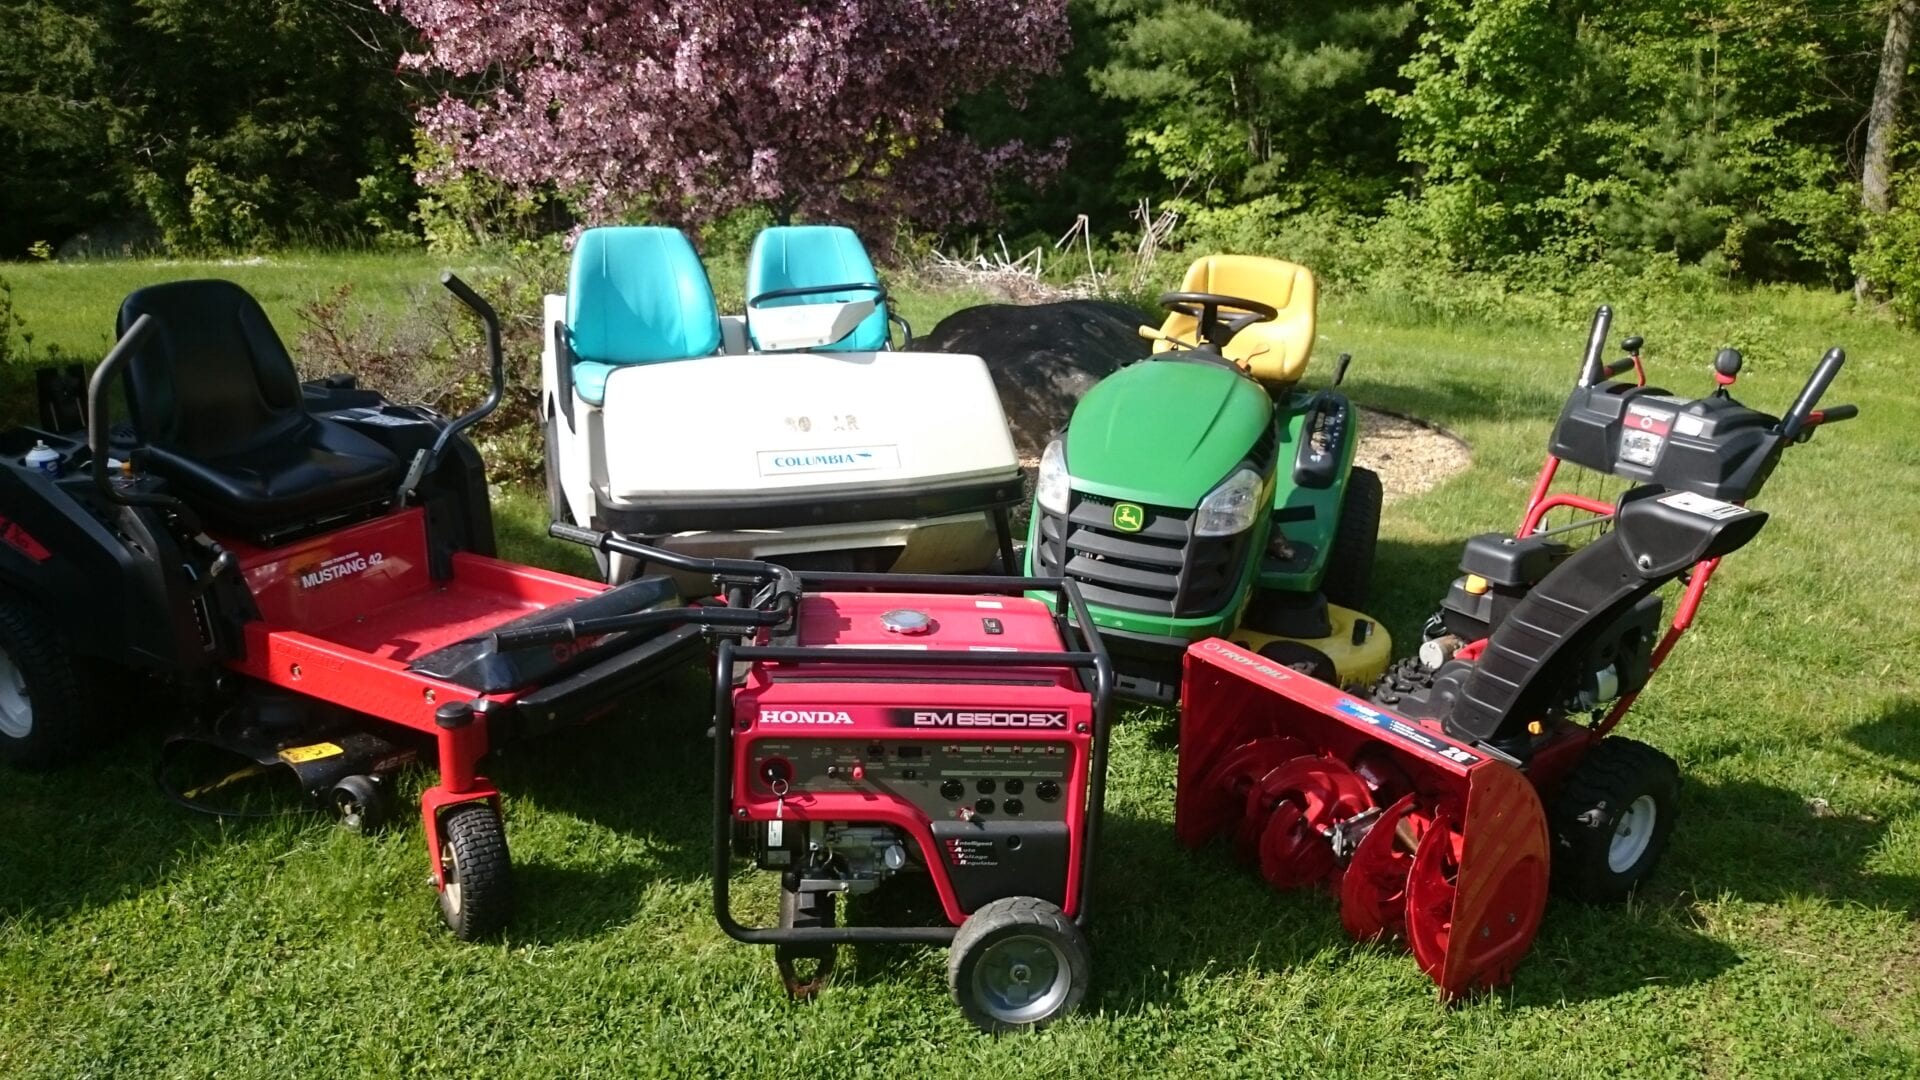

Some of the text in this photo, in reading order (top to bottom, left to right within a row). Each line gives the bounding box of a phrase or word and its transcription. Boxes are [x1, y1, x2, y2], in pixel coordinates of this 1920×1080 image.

[774, 454, 855, 468] COLUMBIA
[301, 557, 368, 588] MUSTANG
[368, 552, 385, 566] 42
[760, 710, 854, 724] HONDA
